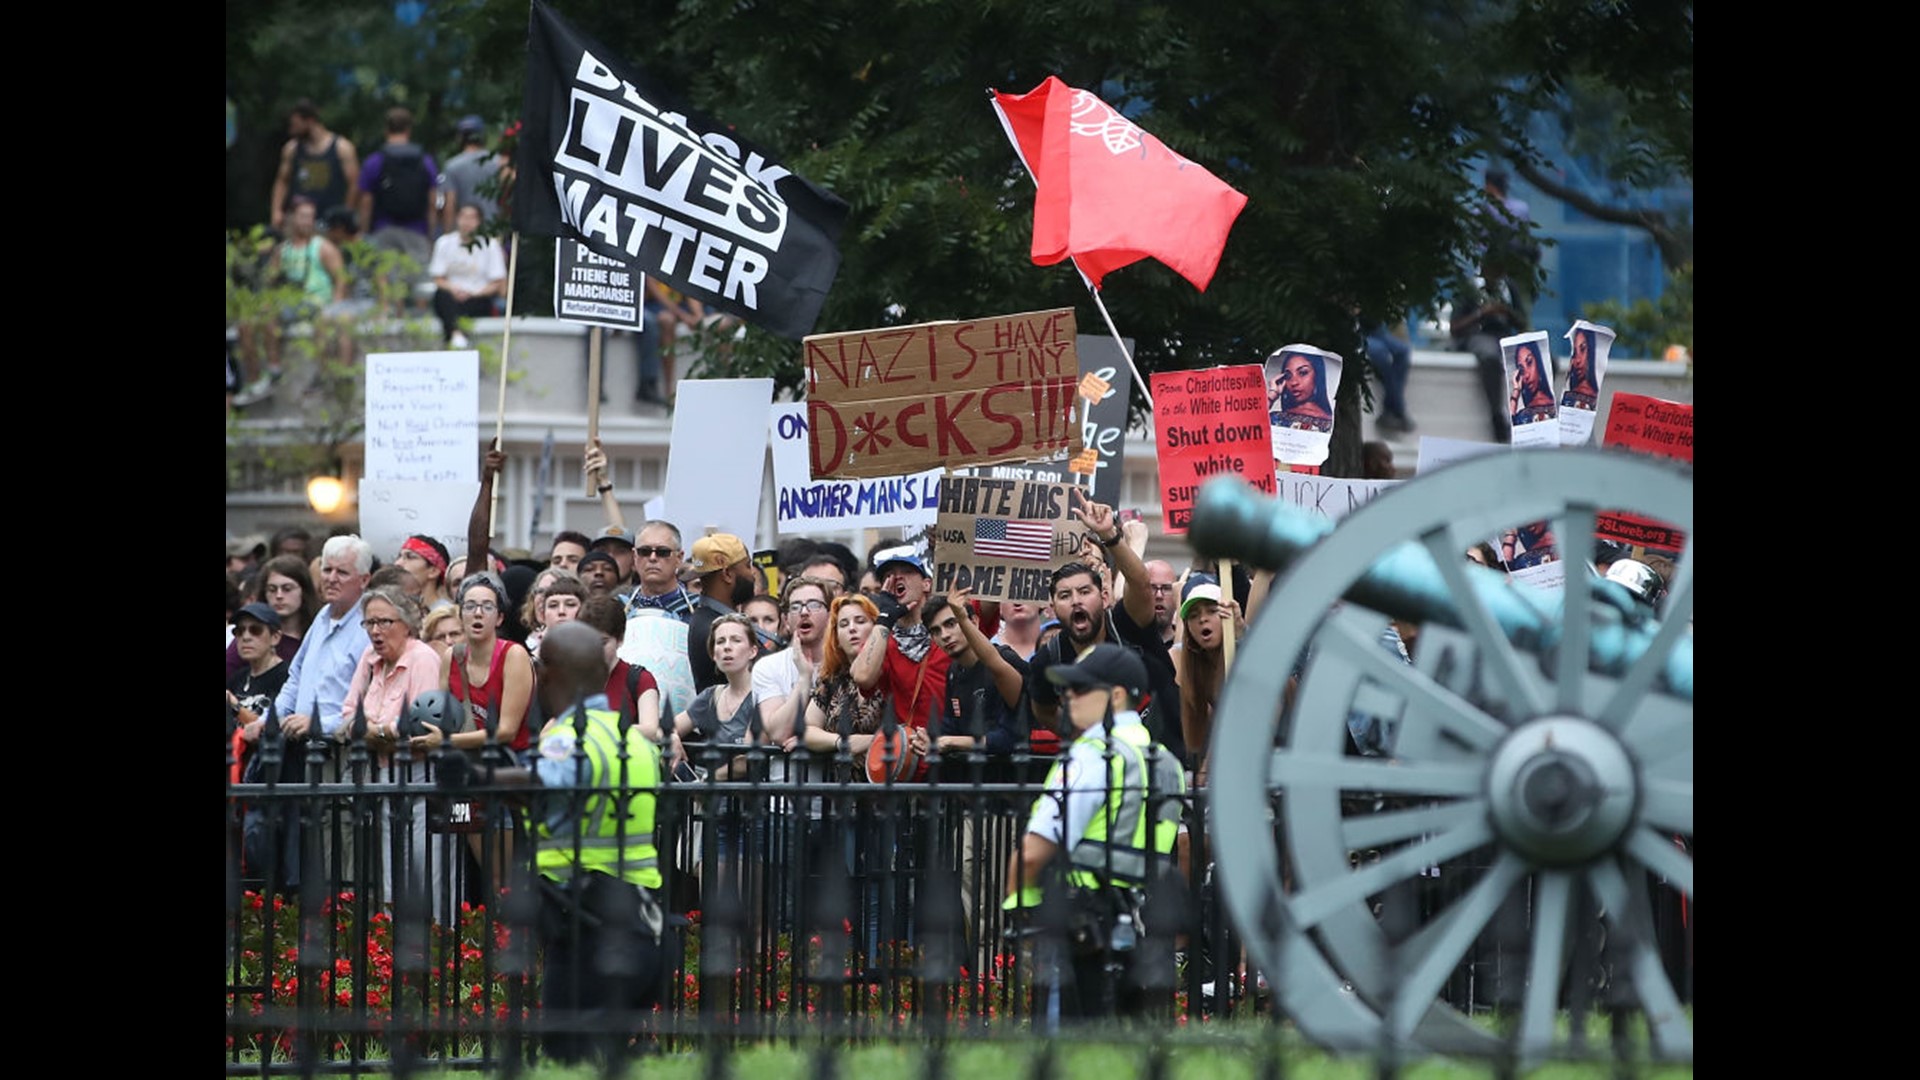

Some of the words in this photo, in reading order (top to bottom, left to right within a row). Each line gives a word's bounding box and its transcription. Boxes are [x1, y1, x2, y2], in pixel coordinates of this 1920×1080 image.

[564, 97, 782, 235] LIVES
[553, 172, 769, 311] MATTER
[571, 267, 608, 284] ¡TIENE
[609, 271, 630, 287] QUE
[564, 283, 635, 304] MARCHARSE!
[807, 325, 978, 394] NAZIS
[995, 313, 1071, 349] HAVE
[1158, 383, 1183, 397] From
[1186, 372, 1262, 395] Charlottesville
[1161, 406, 1171, 416] to
[1173, 402, 1188, 415] the
[1190, 399, 1221, 416] White
[1224, 396, 1262, 412] House:
[1616, 402, 1641, 415] From
[1167, 424, 1209, 448] Shut
[1214, 422, 1263, 443] down
[1643, 425, 1675, 445] White
[1678, 431, 1693, 447] Ho
[992, 467, 1033, 480] MUST
[1193, 453, 1244, 476] white
[779, 482, 854, 521] ANOTHER
[855, 475, 918, 516] MAN'S
[940, 478, 1015, 516] HATE
[1018, 482, 1063, 520] HAS
[1168, 474, 1272, 503] supcy!
[1276, 478, 1334, 518] UCK
[1597, 517, 1666, 543] PSLweb.org
[936, 563, 1006, 596] HOME
[1008, 567, 1052, 601] HERE
